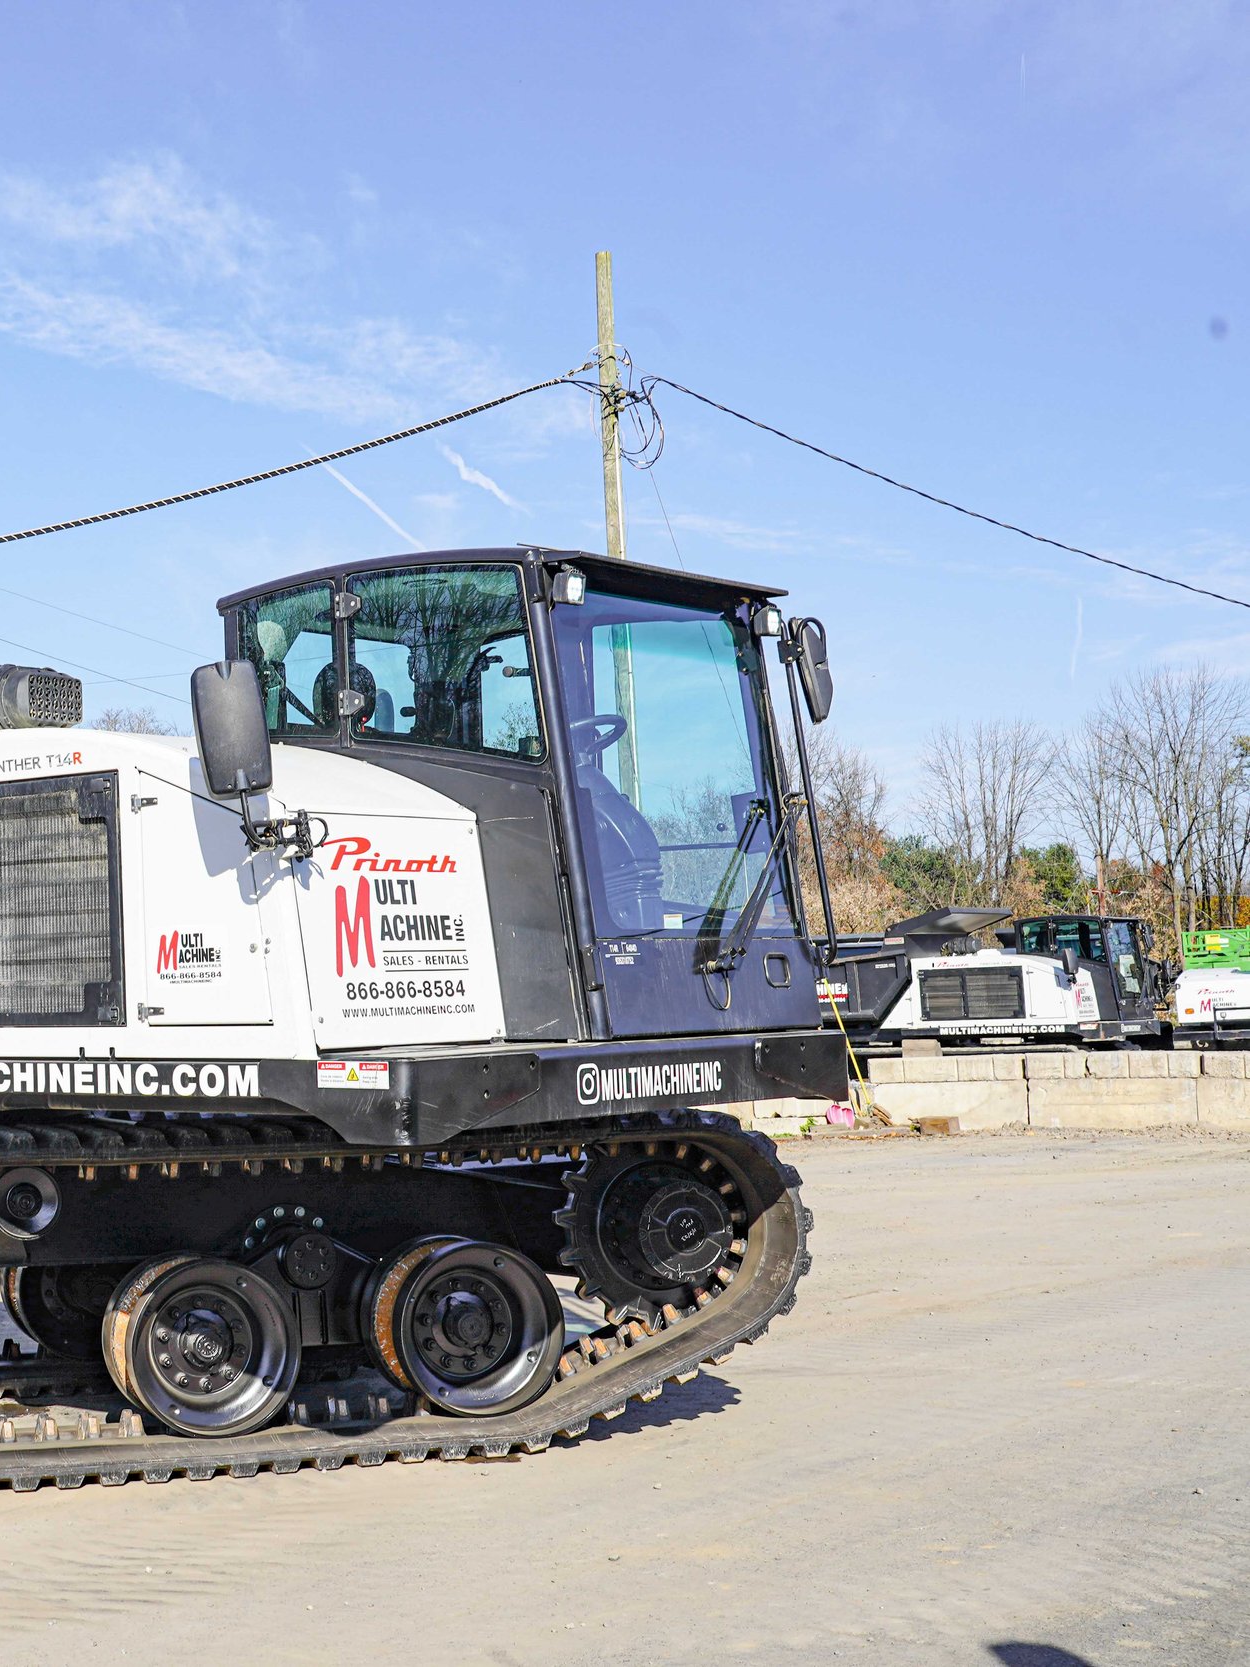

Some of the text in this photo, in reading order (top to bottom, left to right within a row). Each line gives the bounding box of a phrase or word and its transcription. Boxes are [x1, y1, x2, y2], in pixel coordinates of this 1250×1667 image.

[46, 751, 83, 768] T14R
[322, 836, 457, 873] Prinoth
[454, 914, 465, 942] INC.
[383, 955, 414, 967] SALES
[425, 954, 469, 966] RENTALS
[160, 971, 222, 981] 866-866-8584
[346, 979, 466, 1001] 866-866-8584
[342, 1004, 476, 1018] WWW.MULTIMACHINEINC.COM
[940, 1025, 1066, 1035] MULTIMACHINEINC.COM
[601, 1060, 723, 1102] MULTIMACHINEINC
